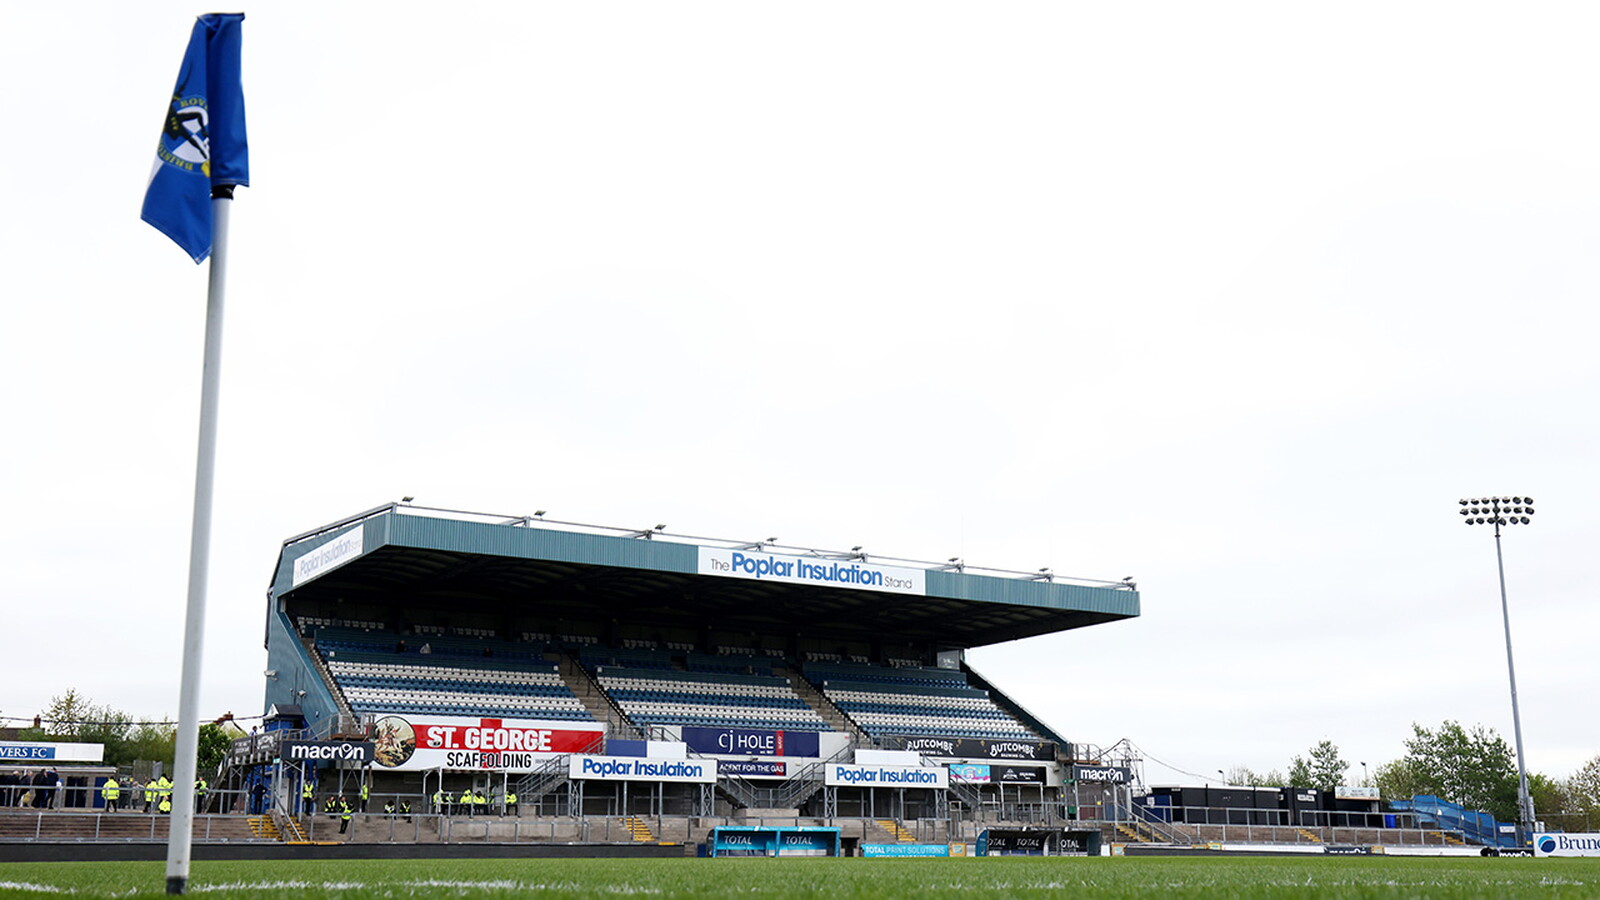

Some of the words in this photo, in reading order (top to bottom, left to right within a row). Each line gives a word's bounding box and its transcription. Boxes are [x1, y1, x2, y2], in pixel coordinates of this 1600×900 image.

[710, 558, 730, 571] The
[732, 552, 793, 578] Poplar
[797, 559, 882, 586] Insulation
[884, 575, 912, 589] Stand
[426, 726, 460, 749] ST.
[464, 728, 552, 751] GEORGE
[738, 734, 774, 749] HOLE
[31, 748, 47, 758] FC
[291, 743, 365, 760] macron
[990, 743, 1036, 759] BUTCOMBE
[446, 752, 532, 769] SCAFFOLDING
[582, 758, 632, 777] Poplar
[635, 760, 702, 777] Insulation
[742, 764, 755, 773] FOR
[756, 764, 769, 773] THE
[770, 764, 784, 774] GAS
[836, 767, 877, 784] Poplar
[880, 768, 937, 784] Insulation
[724, 835, 752, 845] TOTAL
[785, 835, 813, 845] TOTAL
[988, 838, 1006, 847] OTAL
[1016, 838, 1040, 847] TOTAL
[1060, 839, 1080, 848] OTAL
[865, 846, 885, 854] TOTAL
[886, 846, 906, 854] PRINT
[907, 847, 945, 855] SOLUTIONS
